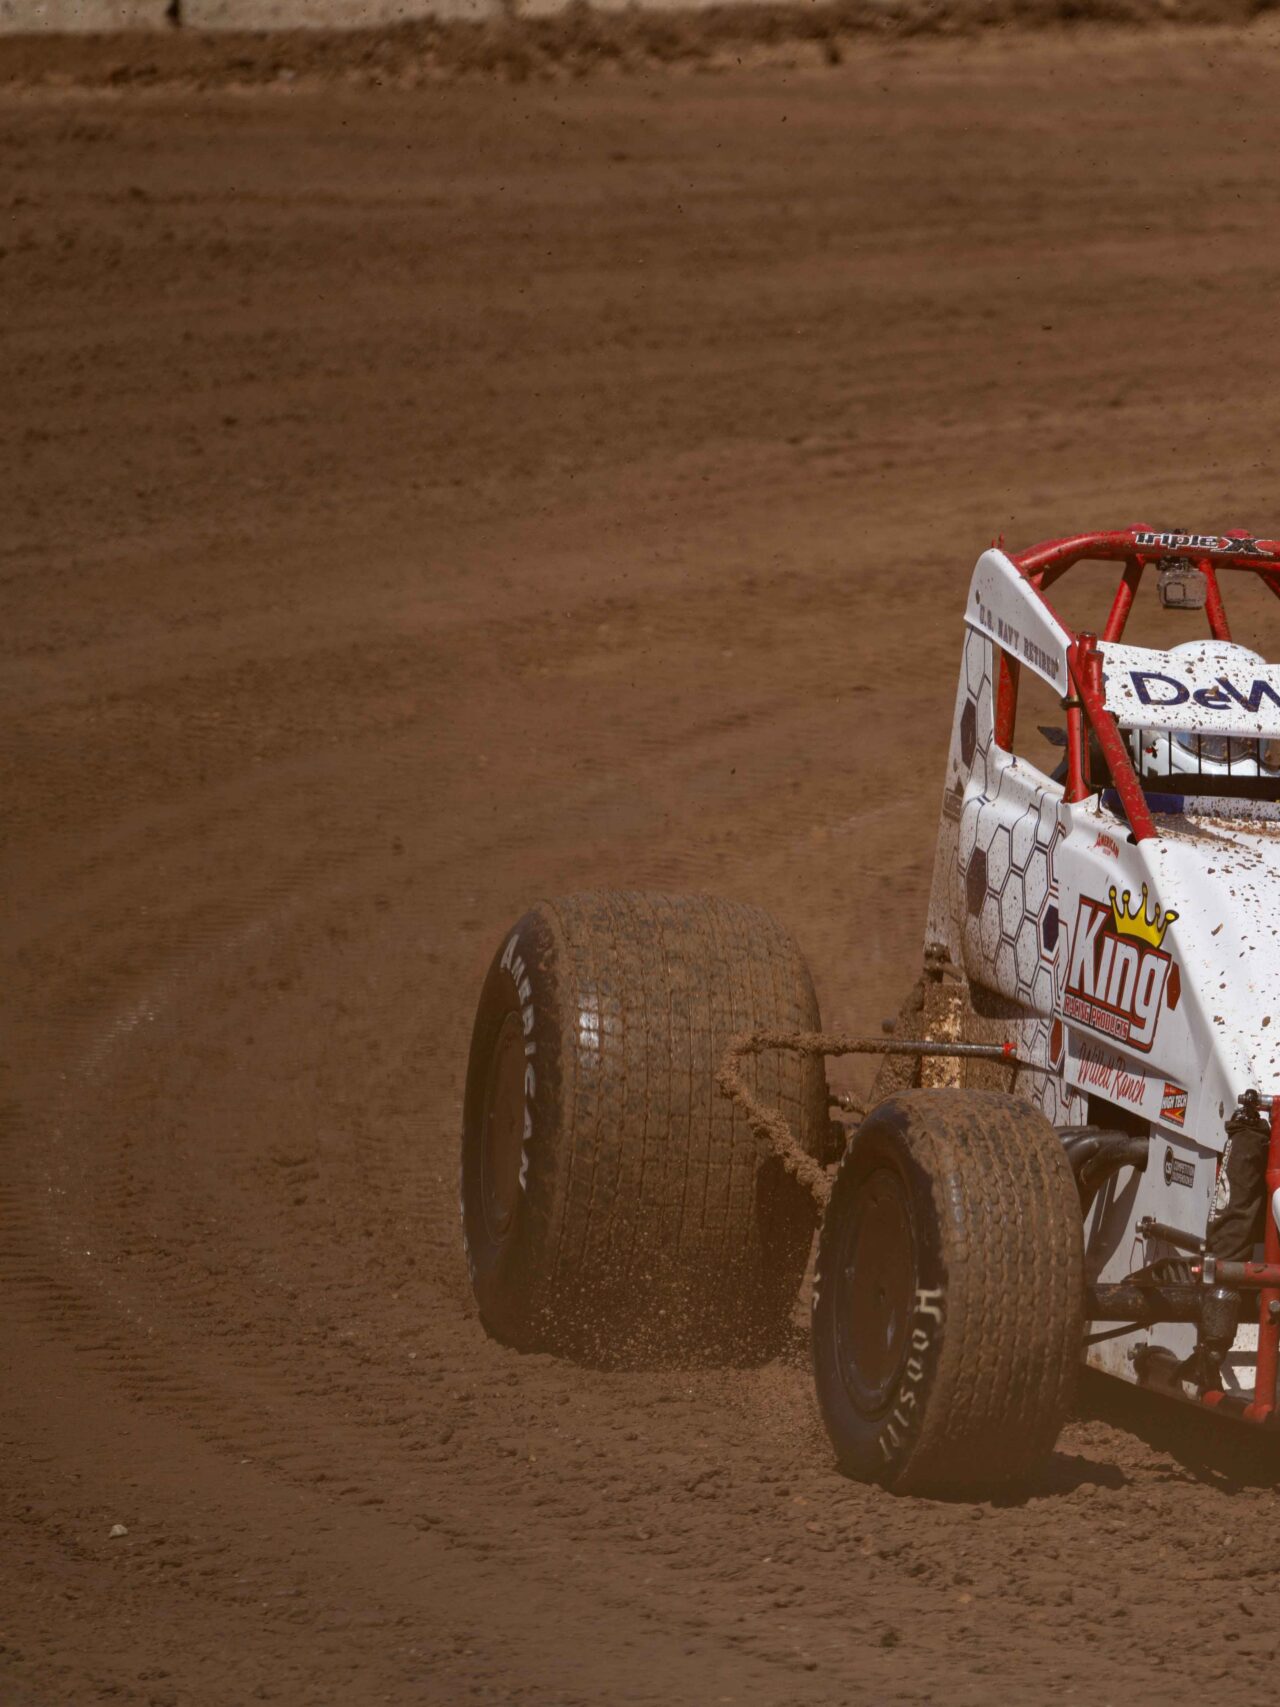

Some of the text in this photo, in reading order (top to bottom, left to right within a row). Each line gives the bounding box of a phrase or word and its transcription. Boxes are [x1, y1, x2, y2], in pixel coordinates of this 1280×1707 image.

[998, 617, 1020, 651] NAVY
[1023, 635, 1059, 681] RETIRED
[1066, 898, 1171, 1049] King
[1064, 995, 1129, 1039] RACING PRODUCTS
[1110, 1055, 1146, 1106] Ranch
